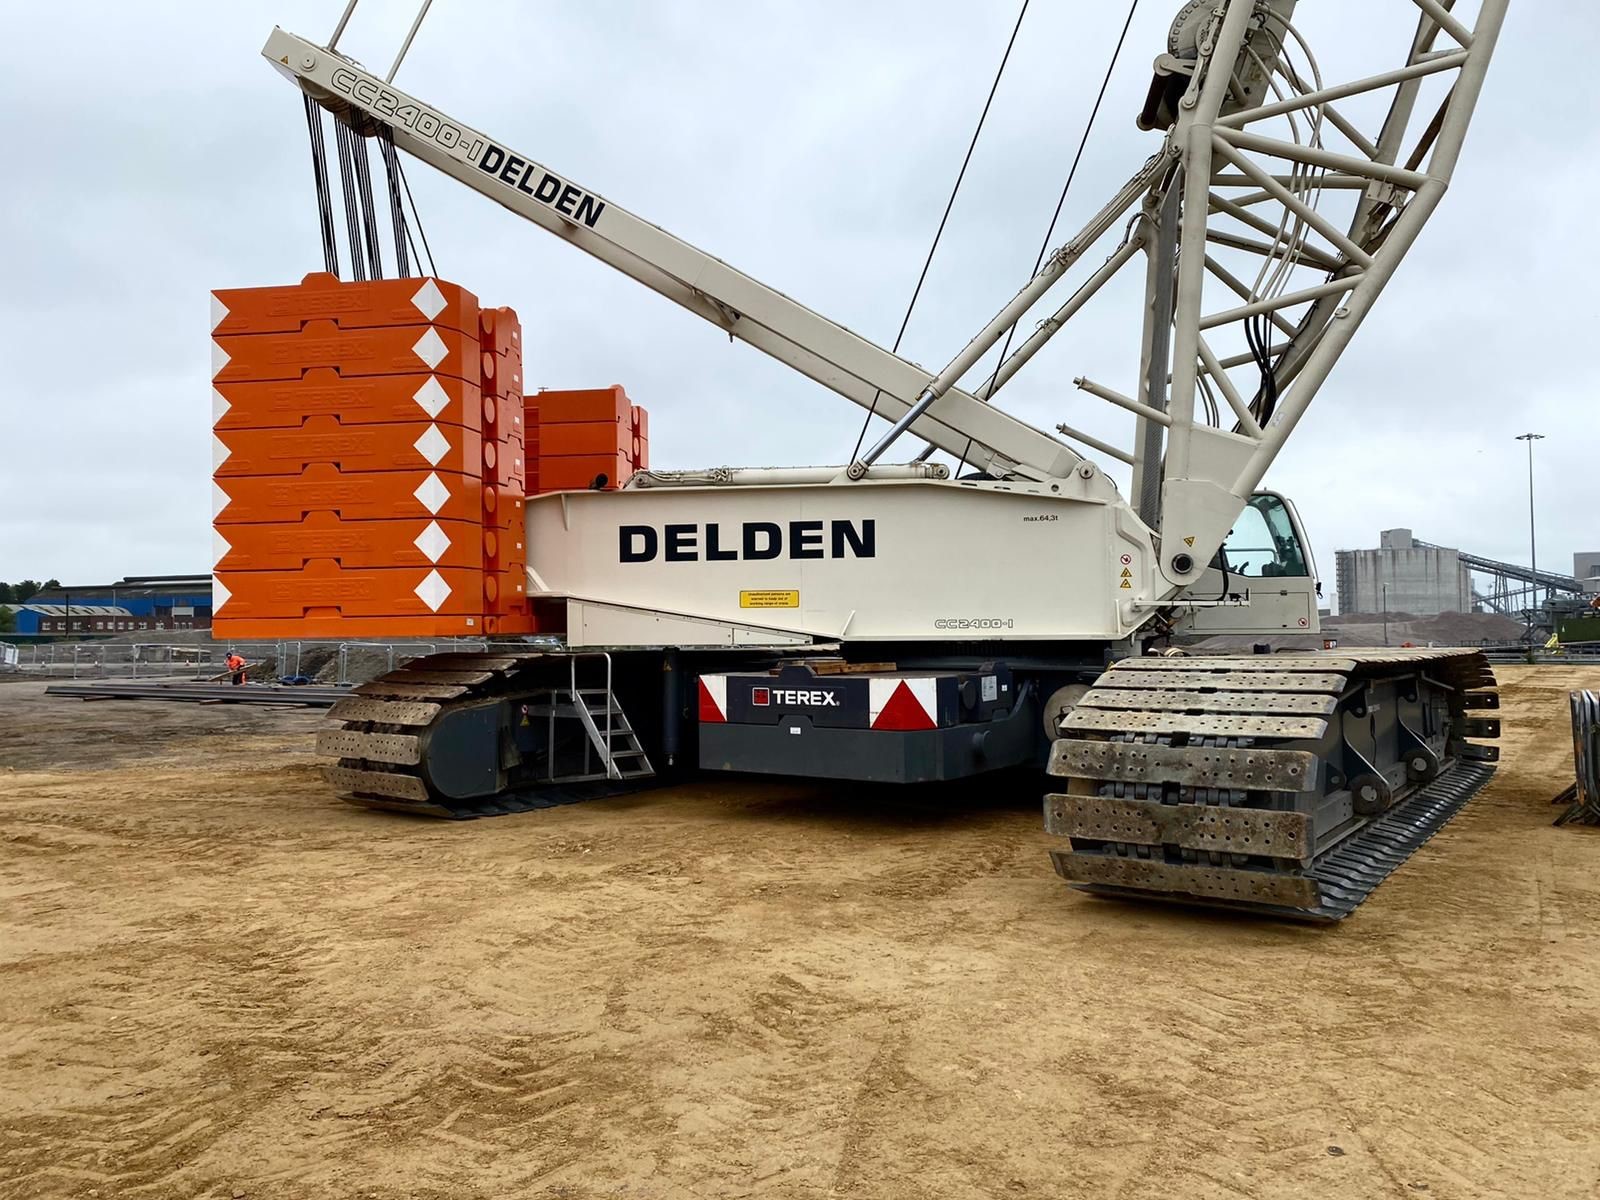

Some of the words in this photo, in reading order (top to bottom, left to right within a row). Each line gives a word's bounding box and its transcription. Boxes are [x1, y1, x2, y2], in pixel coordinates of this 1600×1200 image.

[331, 68, 483, 161] CC2400-I
[478, 144, 605, 228] DELDEN
[619, 519, 876, 563] DELDEN
[934, 618, 1014, 629] CC2400-I
